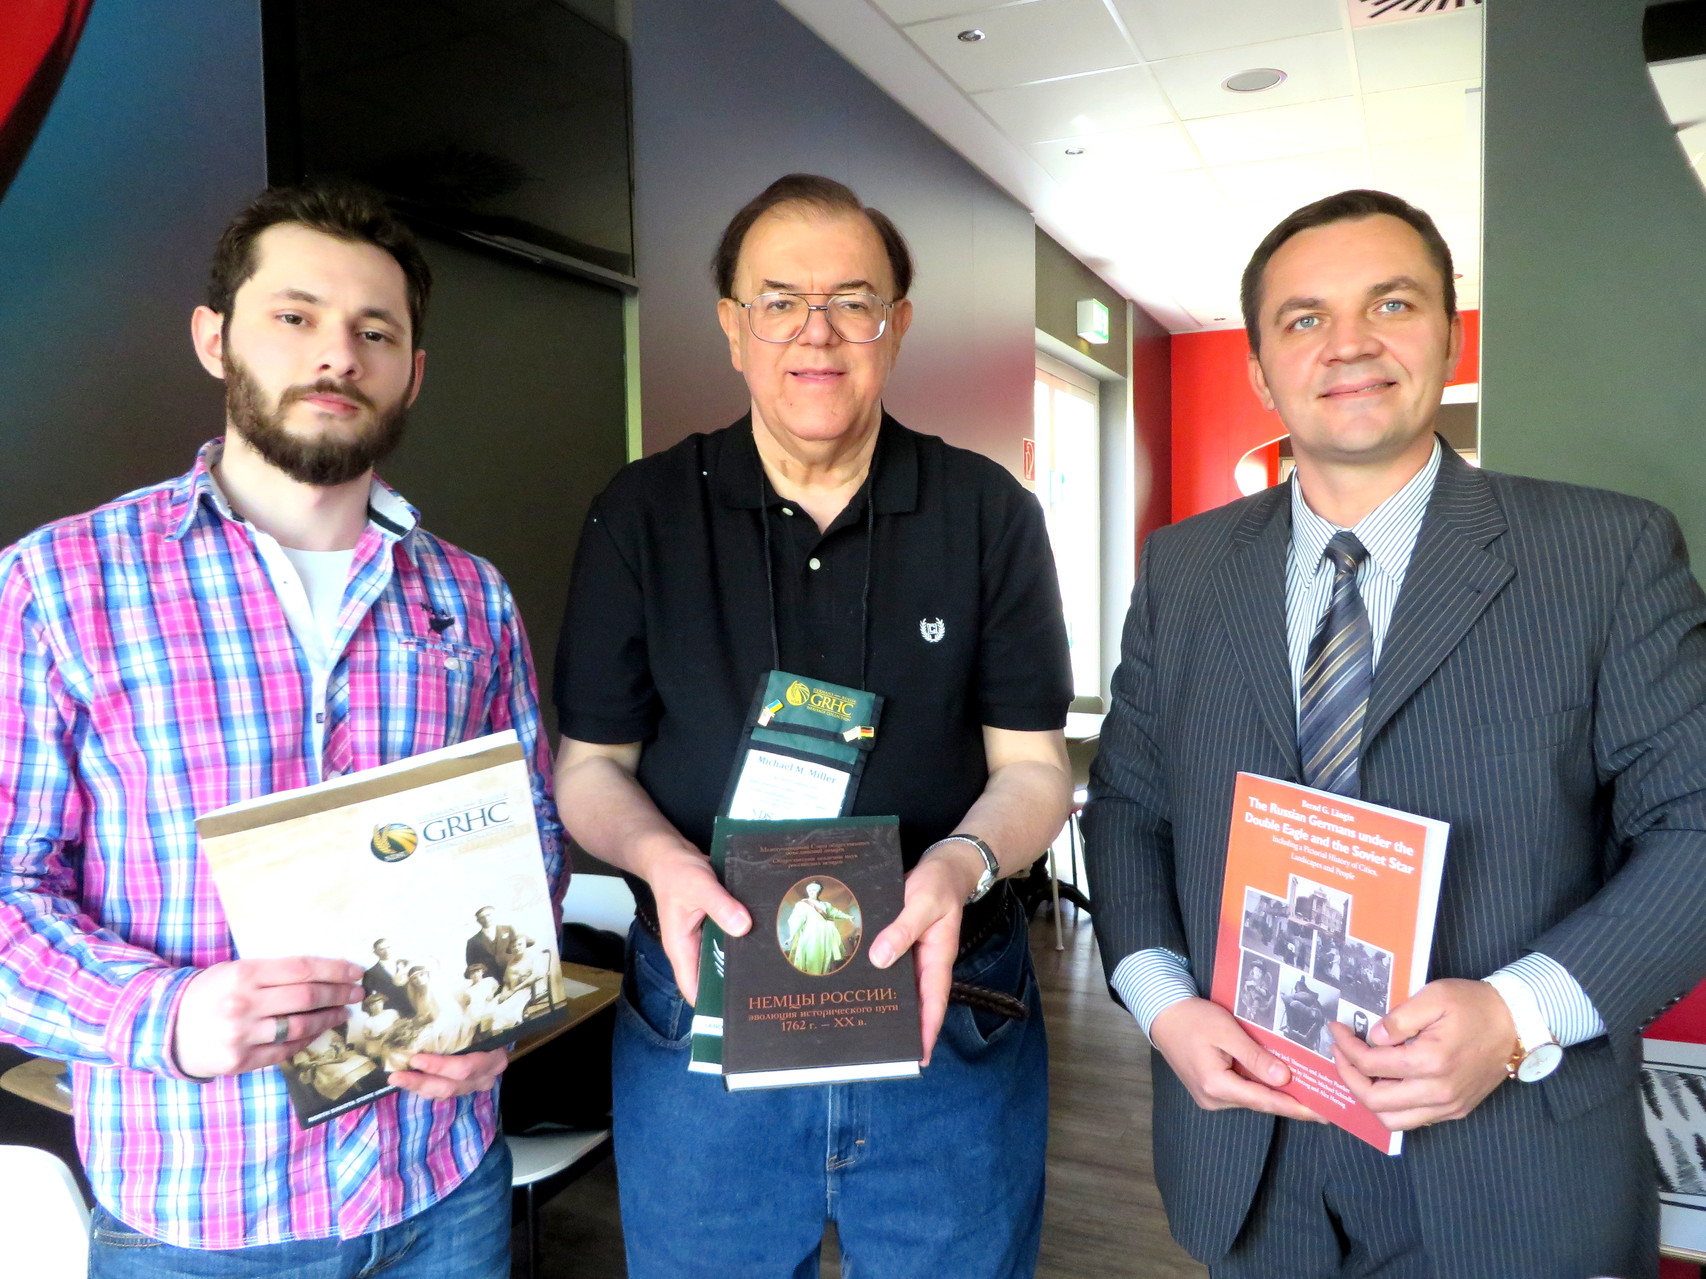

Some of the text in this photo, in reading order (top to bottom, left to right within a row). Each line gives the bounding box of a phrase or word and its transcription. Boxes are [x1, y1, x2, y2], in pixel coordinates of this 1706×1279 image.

[810, 693, 854, 716] GRHC
[757, 755, 837, 784] Michael M. Miller
[1301, 799, 1321, 812] Bernd
[422, 801, 511, 843] GRHC
[1248, 796, 1414, 857] The Russian Germans under the
[1244, 811, 1415, 875] Double Eagle and the Soviet Star
[1322, 864, 1335, 873] and
[748, 987, 898, 1010] НЕМЦЫ РОССИИ:
[748, 1003, 899, 1022] эволюция исторического пути
[781, 1020, 806, 1032] 1762
